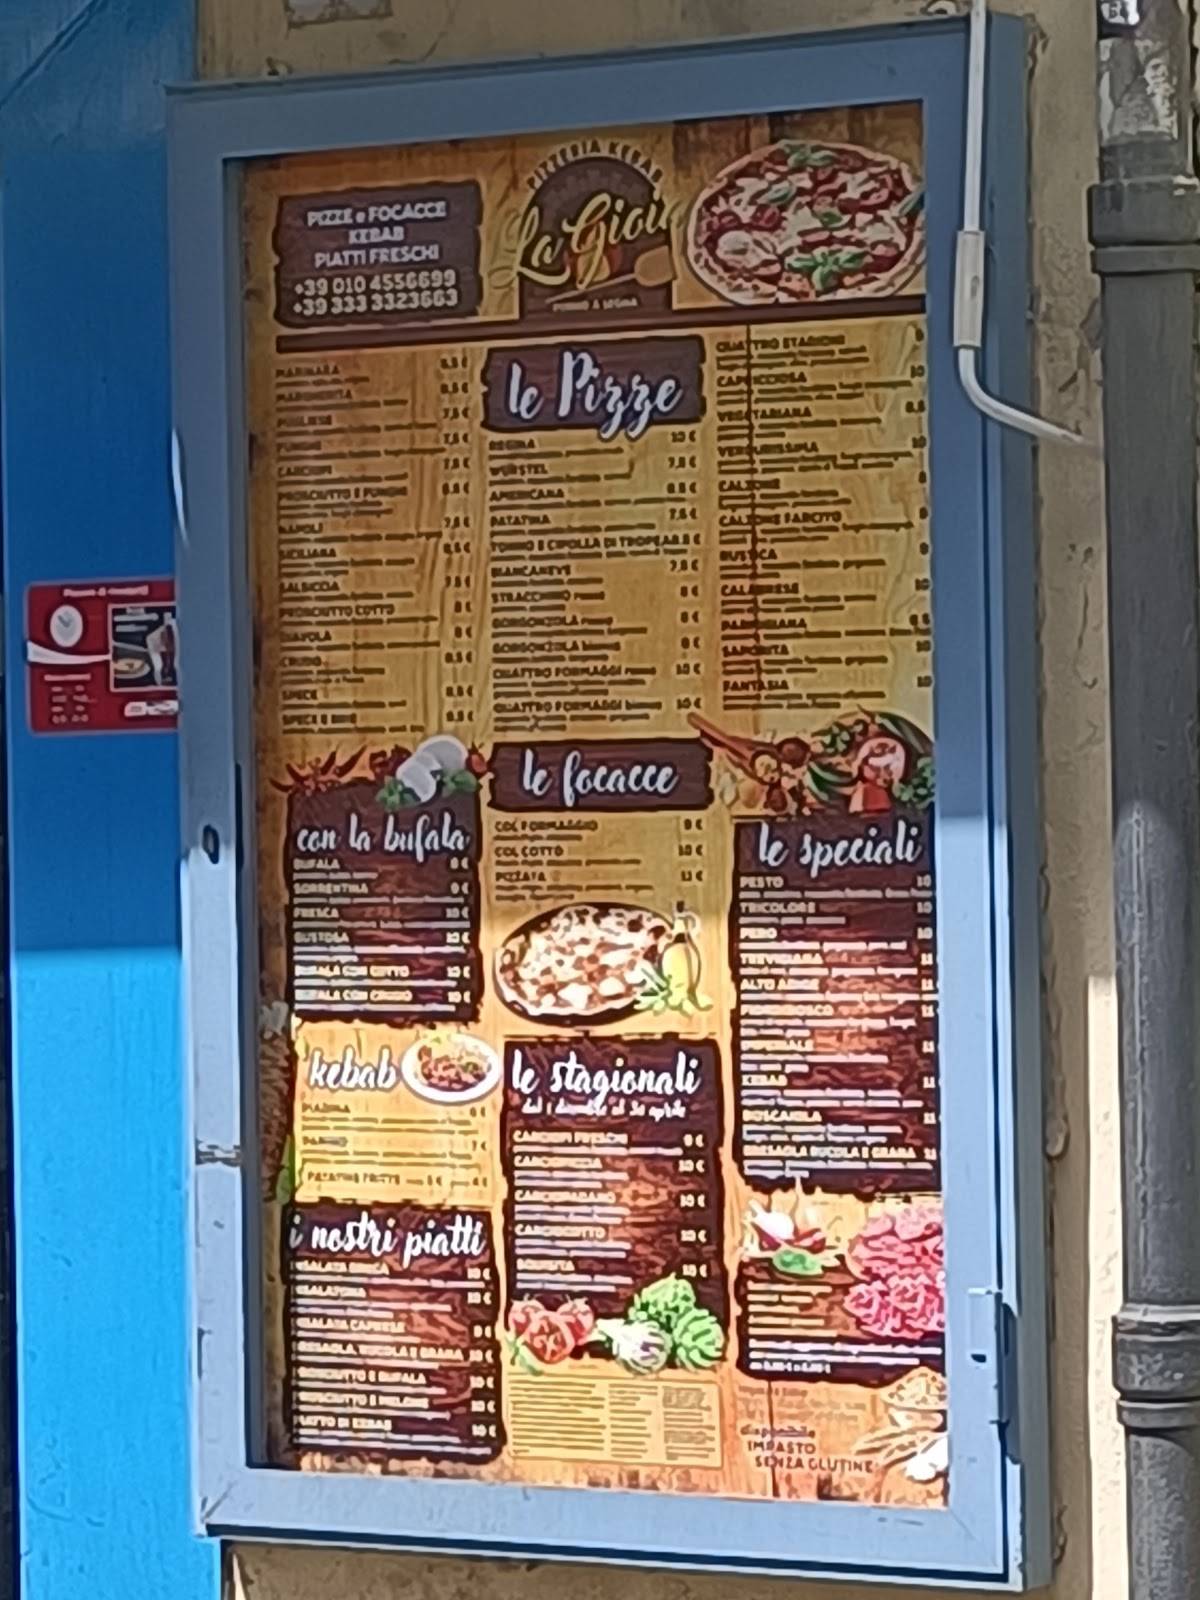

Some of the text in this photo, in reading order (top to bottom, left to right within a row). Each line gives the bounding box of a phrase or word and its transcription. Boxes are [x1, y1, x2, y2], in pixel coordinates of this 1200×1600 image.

[307, 208, 353, 227] PIZZE
[368, 201, 446, 222] FOCACCE
[349, 226, 404, 244] KEBAB
[315, 245, 439, 268] PIATTI FRESCHI
[332, 276, 366, 294] 010
[331, 295, 367, 314] 333
[716, 337, 780, 353] QUATRO
[717, 371, 807, 388] CAPICCIOSA
[509, 351, 683, 440] le Pizze
[717, 406, 813, 422] VEGTARIANA
[719, 548, 778, 562] RUSTCA
[522, 748, 679, 808] le focacce
[296, 811, 470, 863] con la bufala
[759, 820, 922, 879] le speciali
[309, 1046, 399, 1090] kebab
[511, 1049, 702, 1115] le stagionali
[311, 1210, 399, 1257] nostri
[402, 1213, 486, 1270] piatti
[747, 1440, 817, 1454] IMPASTO
[755, 1455, 873, 1473] SENZA GLUTINE
